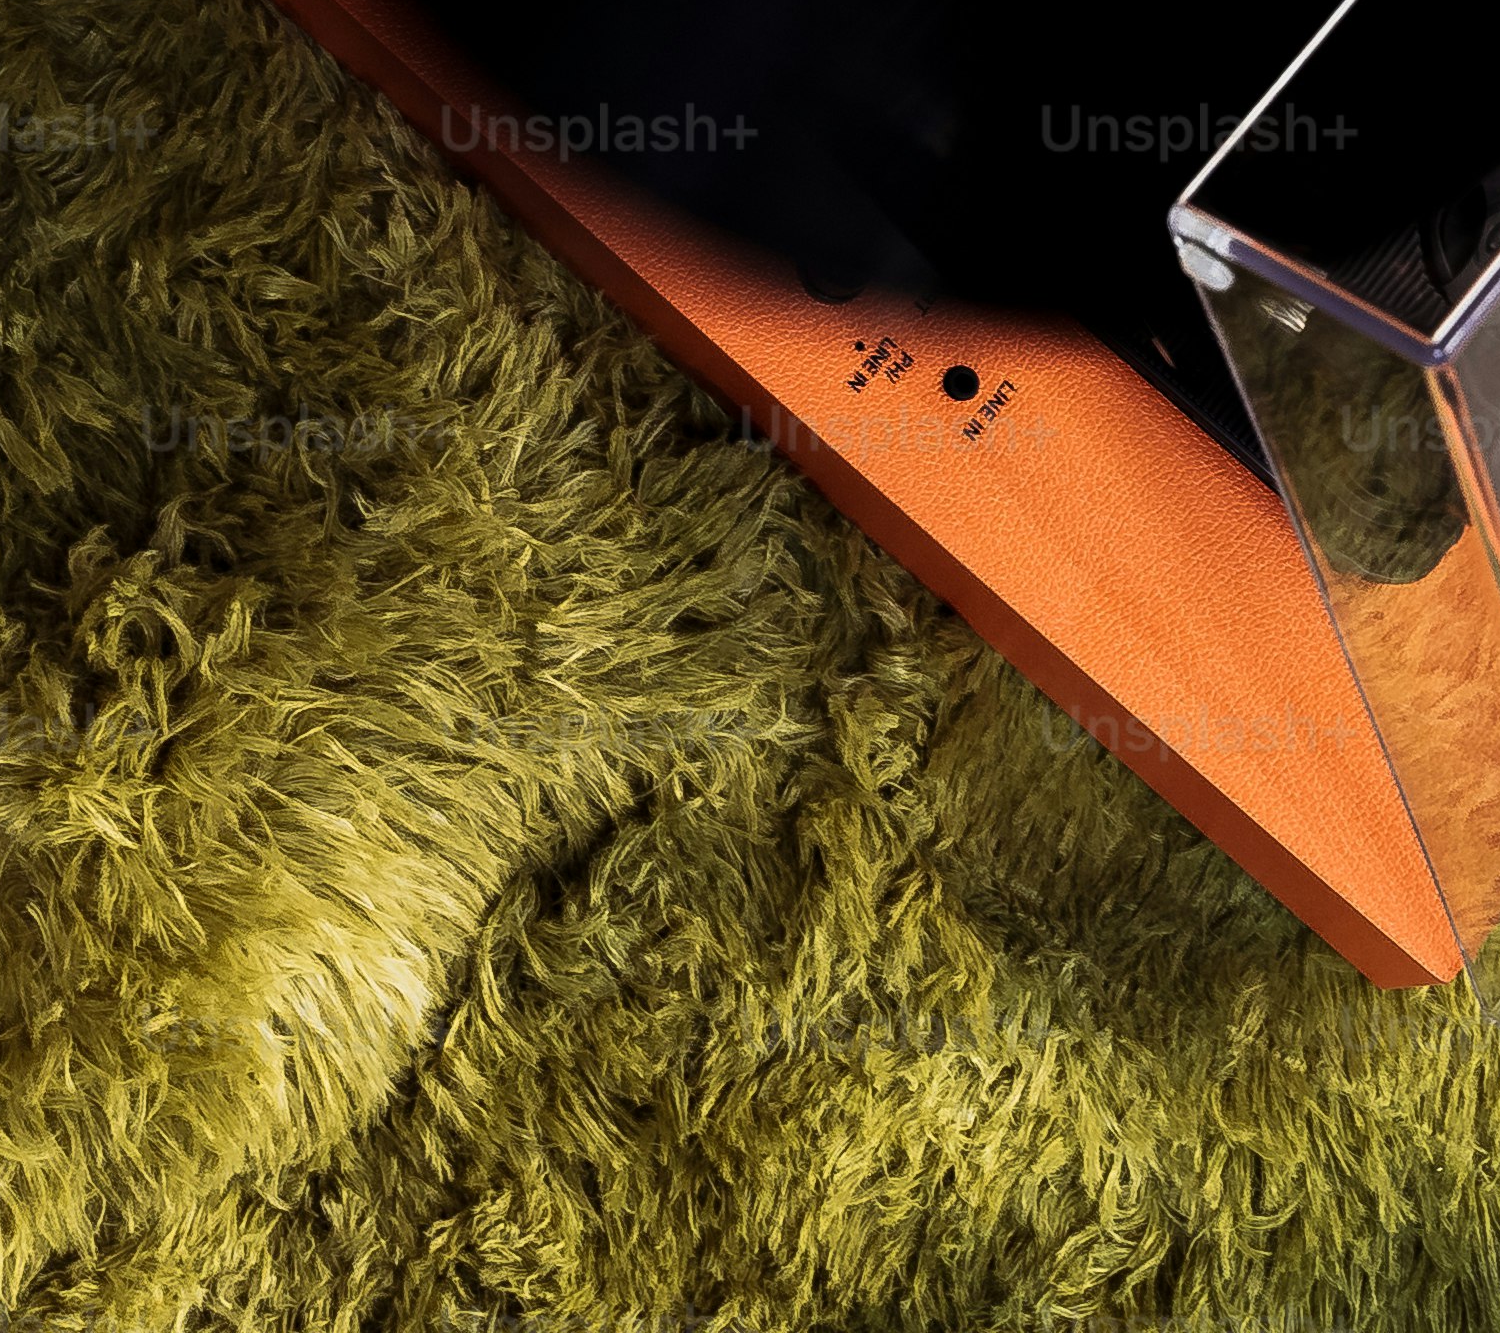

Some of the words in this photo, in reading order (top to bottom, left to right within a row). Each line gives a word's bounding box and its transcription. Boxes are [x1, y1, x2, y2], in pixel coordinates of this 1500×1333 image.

[862, 336, 898, 377] LINE
[847, 370, 869, 394] IN
[978, 379, 1018, 423] LINE
[962, 417, 984, 442] IN
